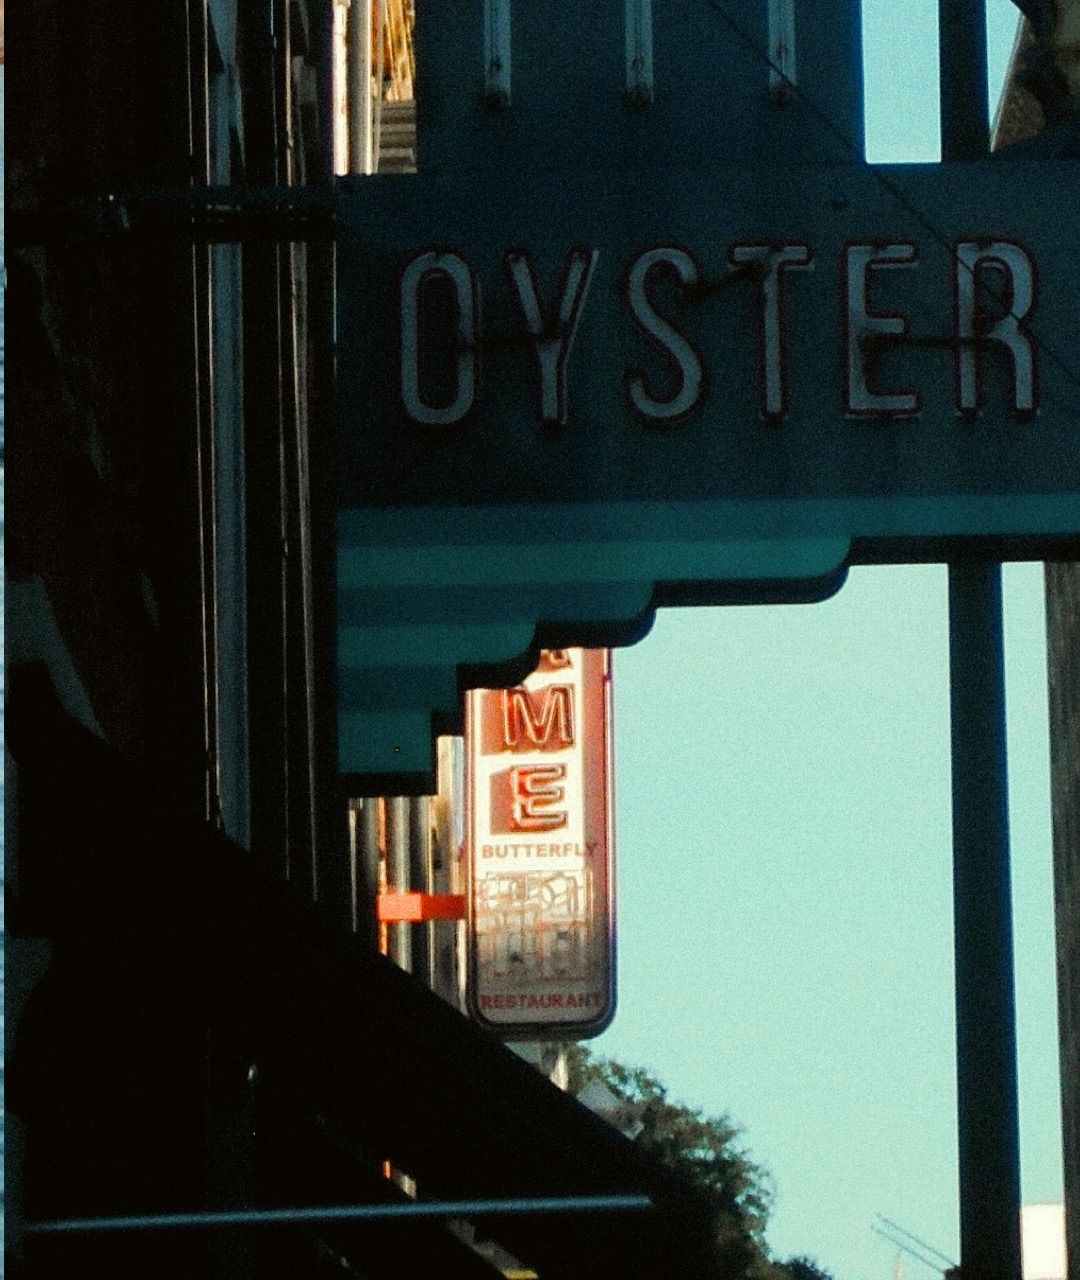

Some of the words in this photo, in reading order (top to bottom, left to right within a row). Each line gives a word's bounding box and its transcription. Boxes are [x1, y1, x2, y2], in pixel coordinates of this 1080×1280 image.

[399, 239, 1040, 428] OYSTER
[481, 842, 598, 860] BUTTERFLY
[480, 992, 606, 1009] RESTAURANT
